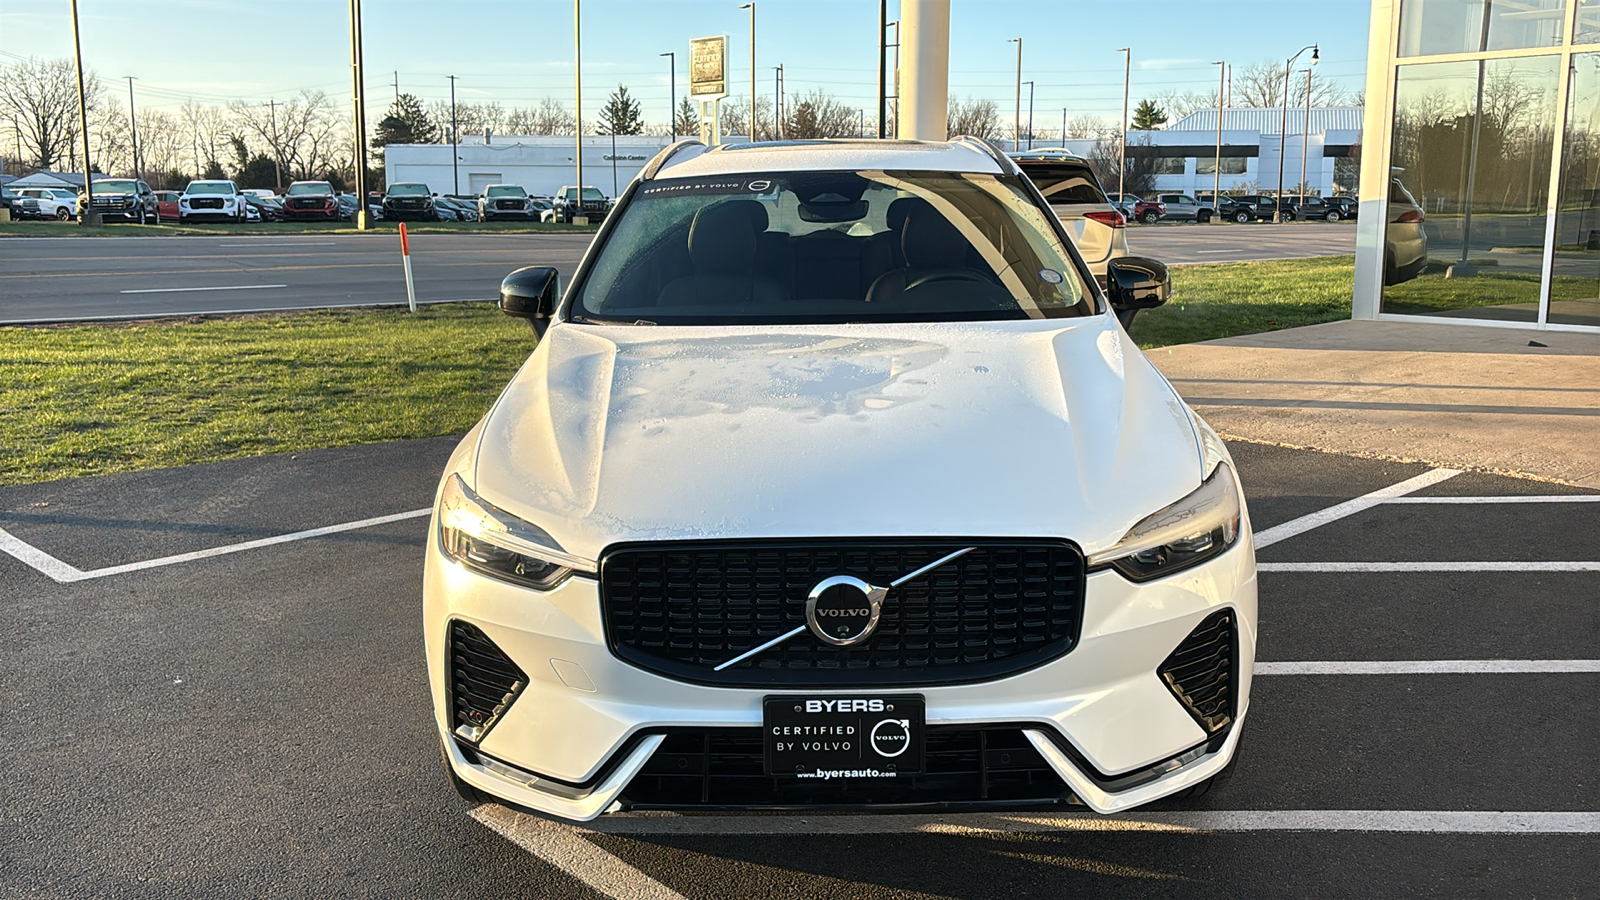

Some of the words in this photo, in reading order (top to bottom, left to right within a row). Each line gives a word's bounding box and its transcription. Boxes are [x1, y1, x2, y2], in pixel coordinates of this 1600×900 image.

[644, 184, 691, 194] CERTIFIED
[816, 608, 870, 617] VOLVO
[806, 700, 884, 712] BYERS
[773, 726, 855, 735] CERTIFIED
[777, 742, 794, 750] BY
[802, 742, 851, 750] VOLVO
[797, 768, 896, 780] www.byersauto.com
